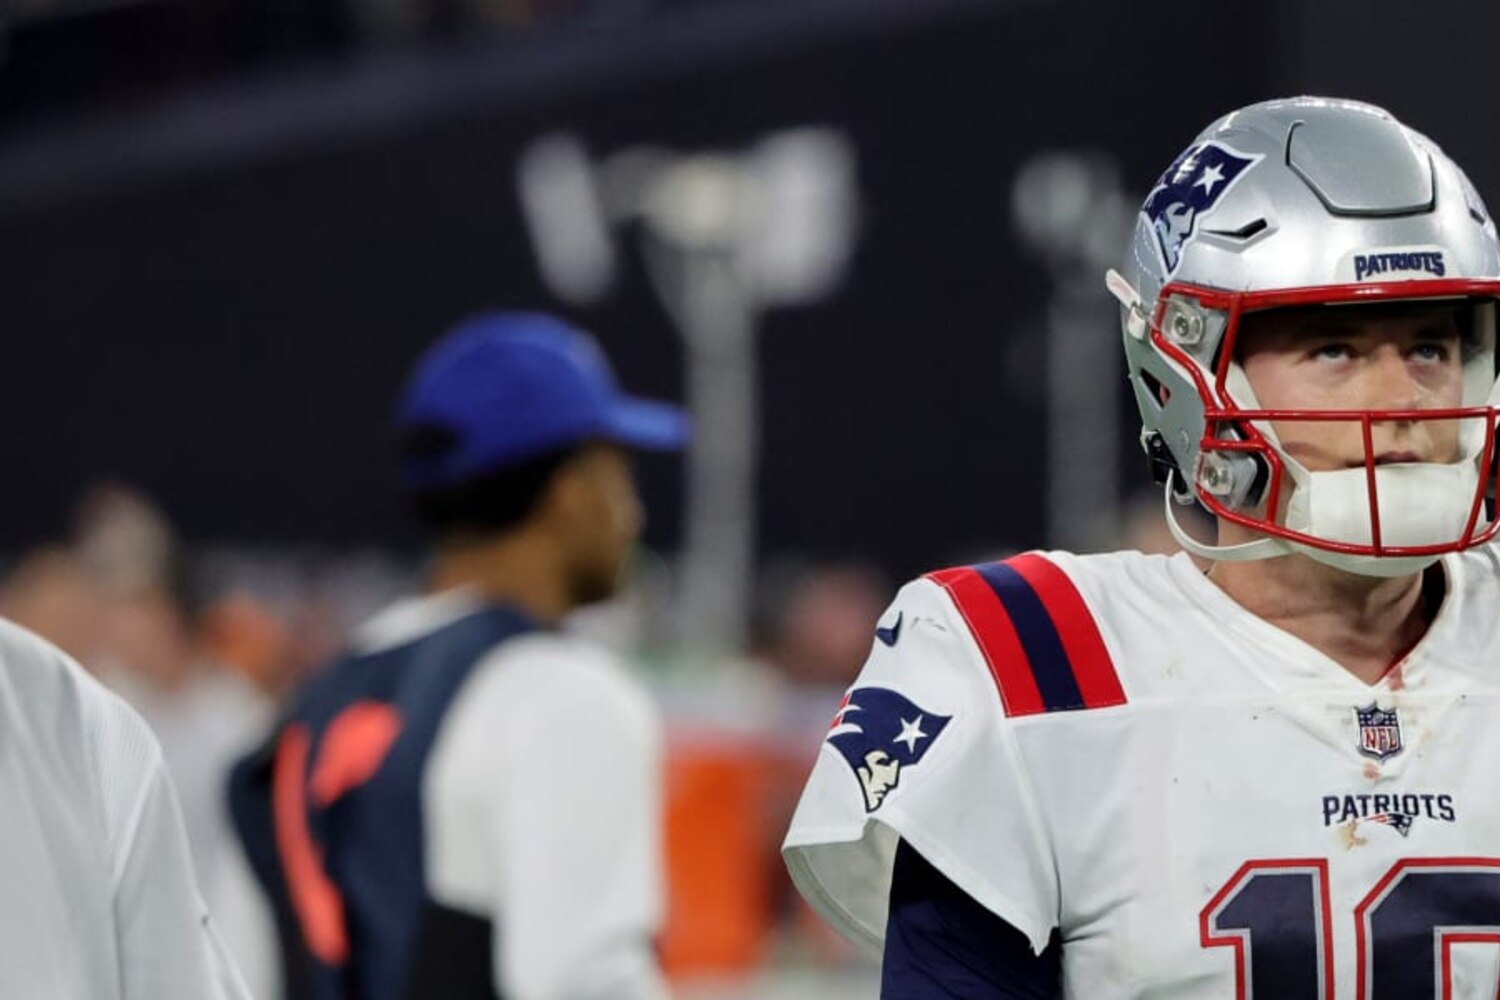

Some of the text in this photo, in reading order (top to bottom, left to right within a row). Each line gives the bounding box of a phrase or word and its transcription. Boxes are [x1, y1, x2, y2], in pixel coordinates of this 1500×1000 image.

[1354, 251, 1446, 281] PATRIOTS
[1363, 727, 1399, 750] NFL
[1322, 793, 1456, 827] PATRIOTS
